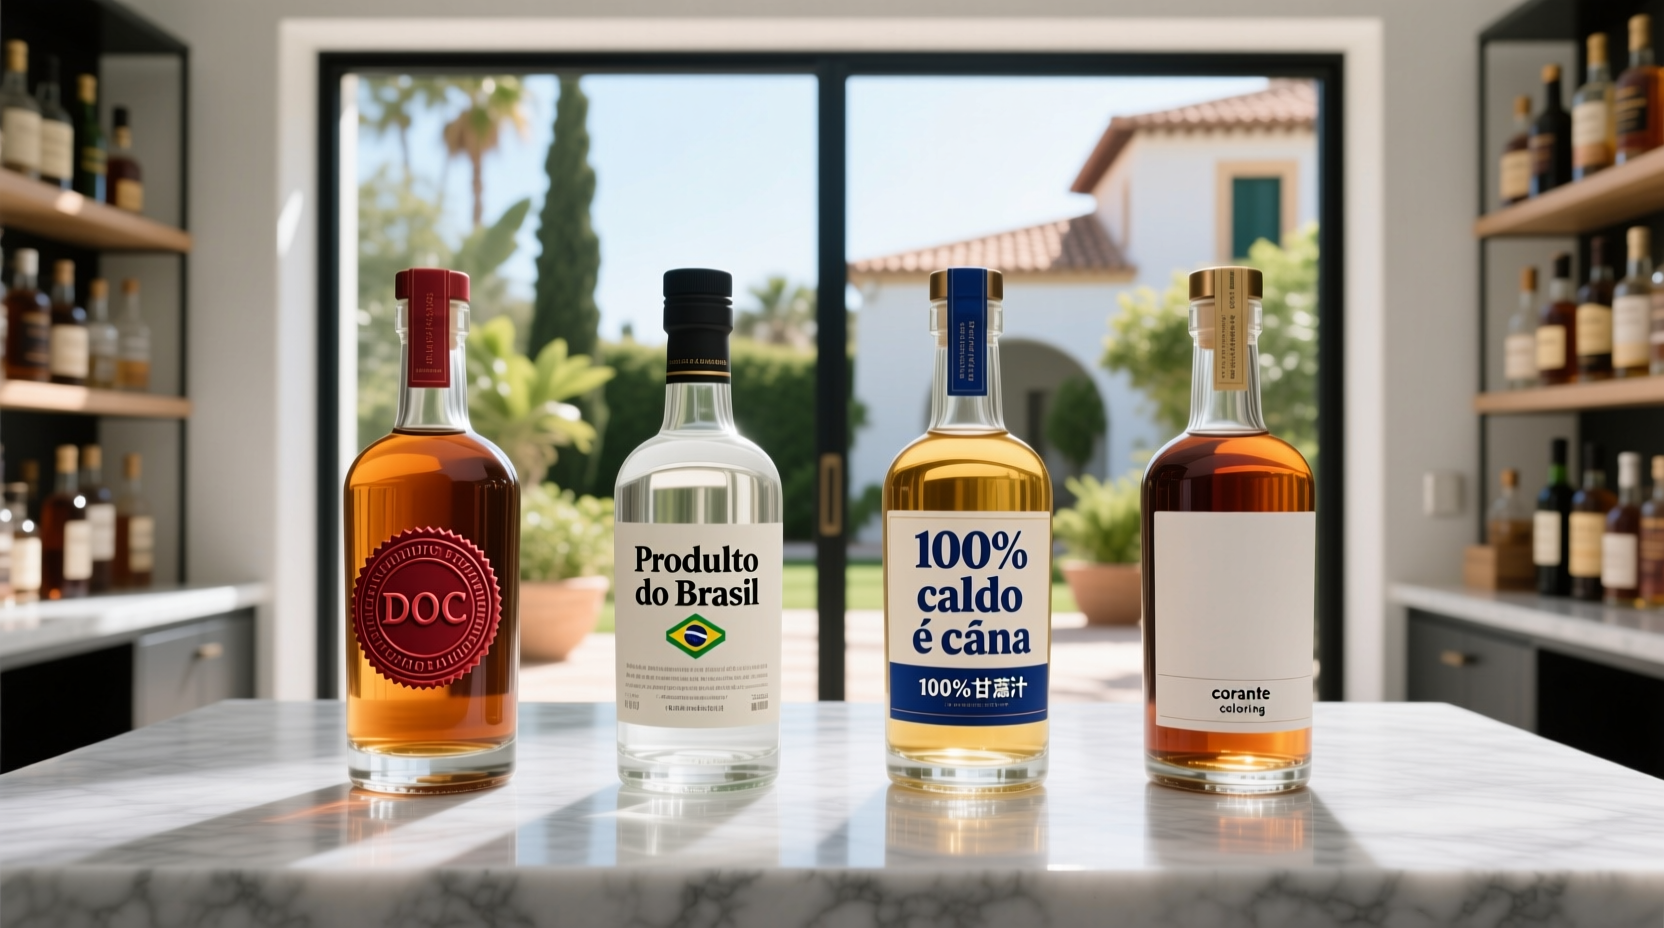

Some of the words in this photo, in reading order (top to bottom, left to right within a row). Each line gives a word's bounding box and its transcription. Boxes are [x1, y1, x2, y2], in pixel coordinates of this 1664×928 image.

[634, 545, 759, 574] Produlto
[914, 530, 1028, 569] 100%
[382, 591, 467, 625] DOC
[635, 578, 669, 606] do
[675, 578, 759, 606] Brasil
[917, 576, 1023, 613] caldo
[912, 618, 933, 654] é
[1212, 687, 1270, 700] corante
